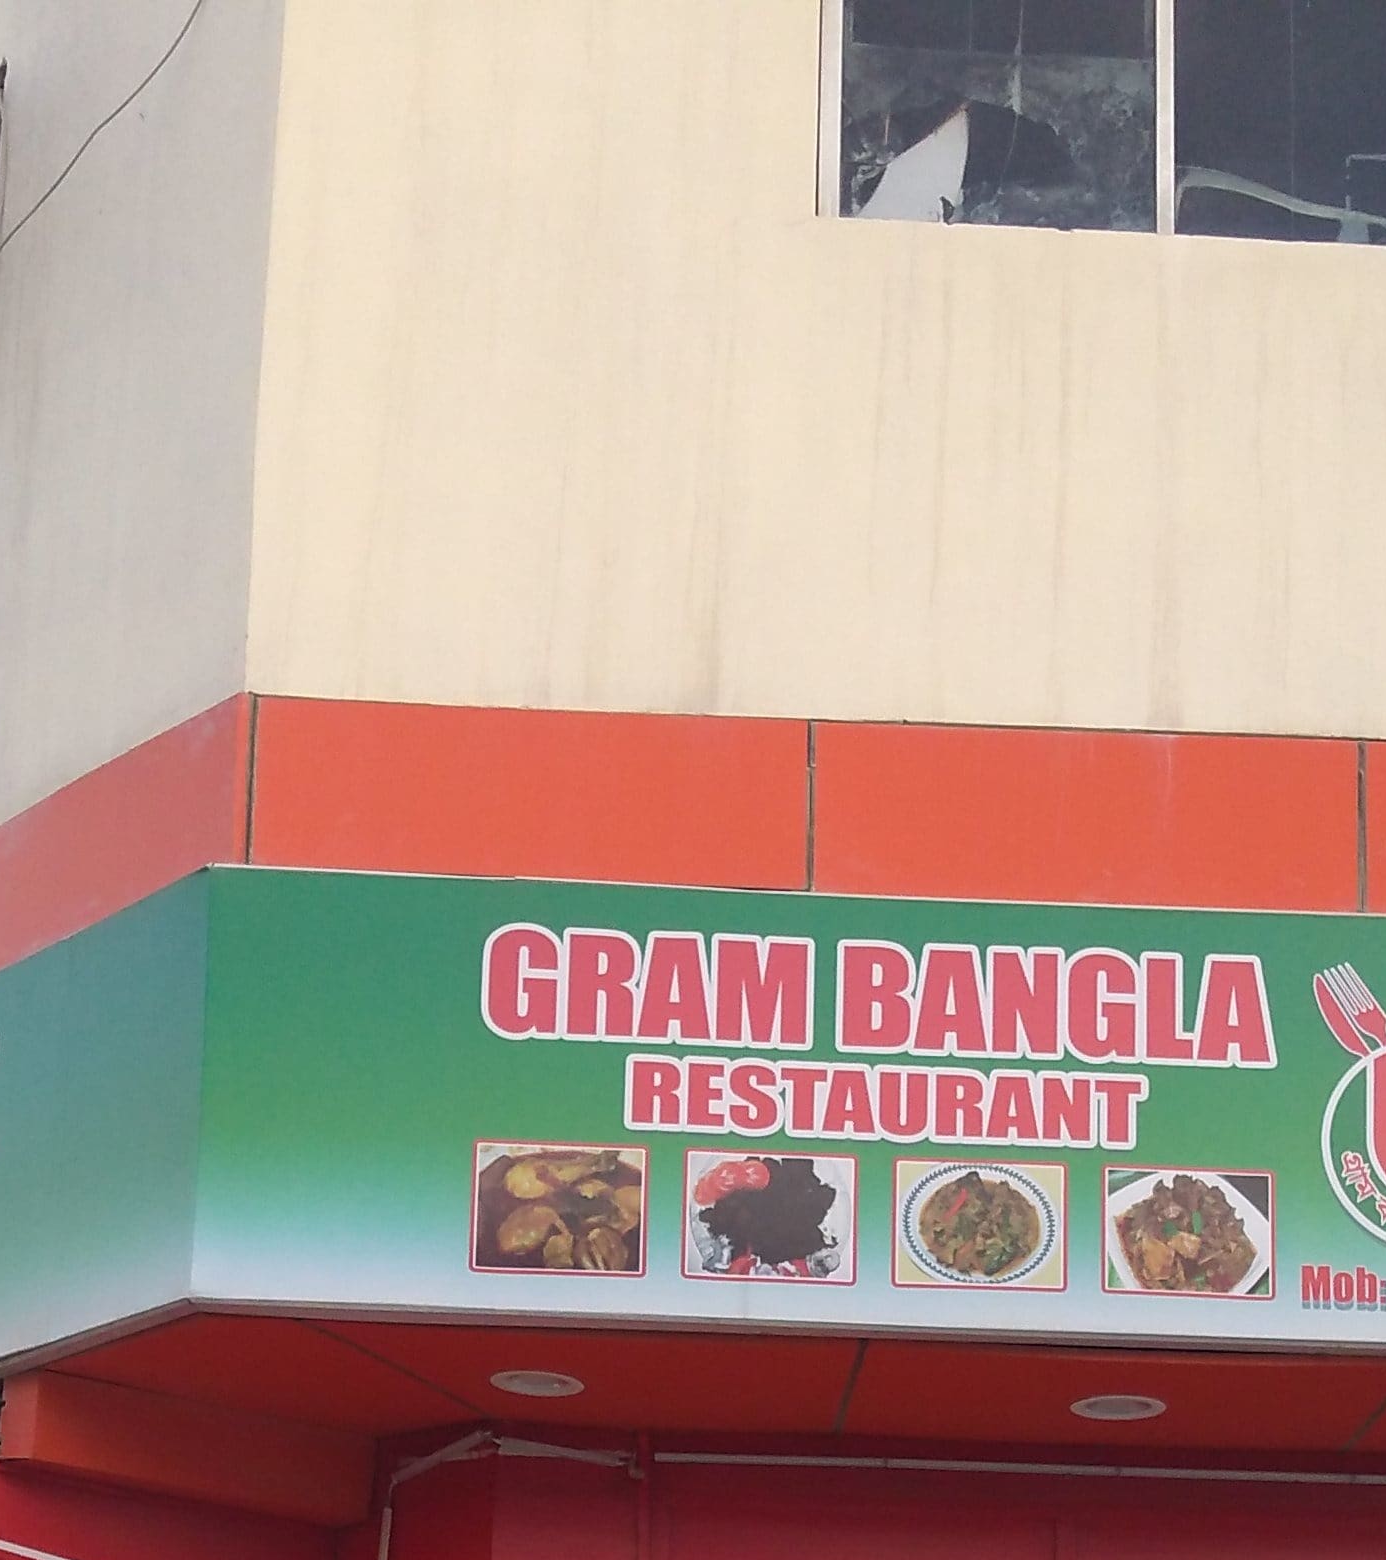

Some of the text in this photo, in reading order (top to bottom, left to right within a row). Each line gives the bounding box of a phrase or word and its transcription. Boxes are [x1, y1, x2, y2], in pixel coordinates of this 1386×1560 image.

[481, 922, 1278, 1068] GRAM BANGLA
[624, 1053, 1149, 1151] RESTAURANT
